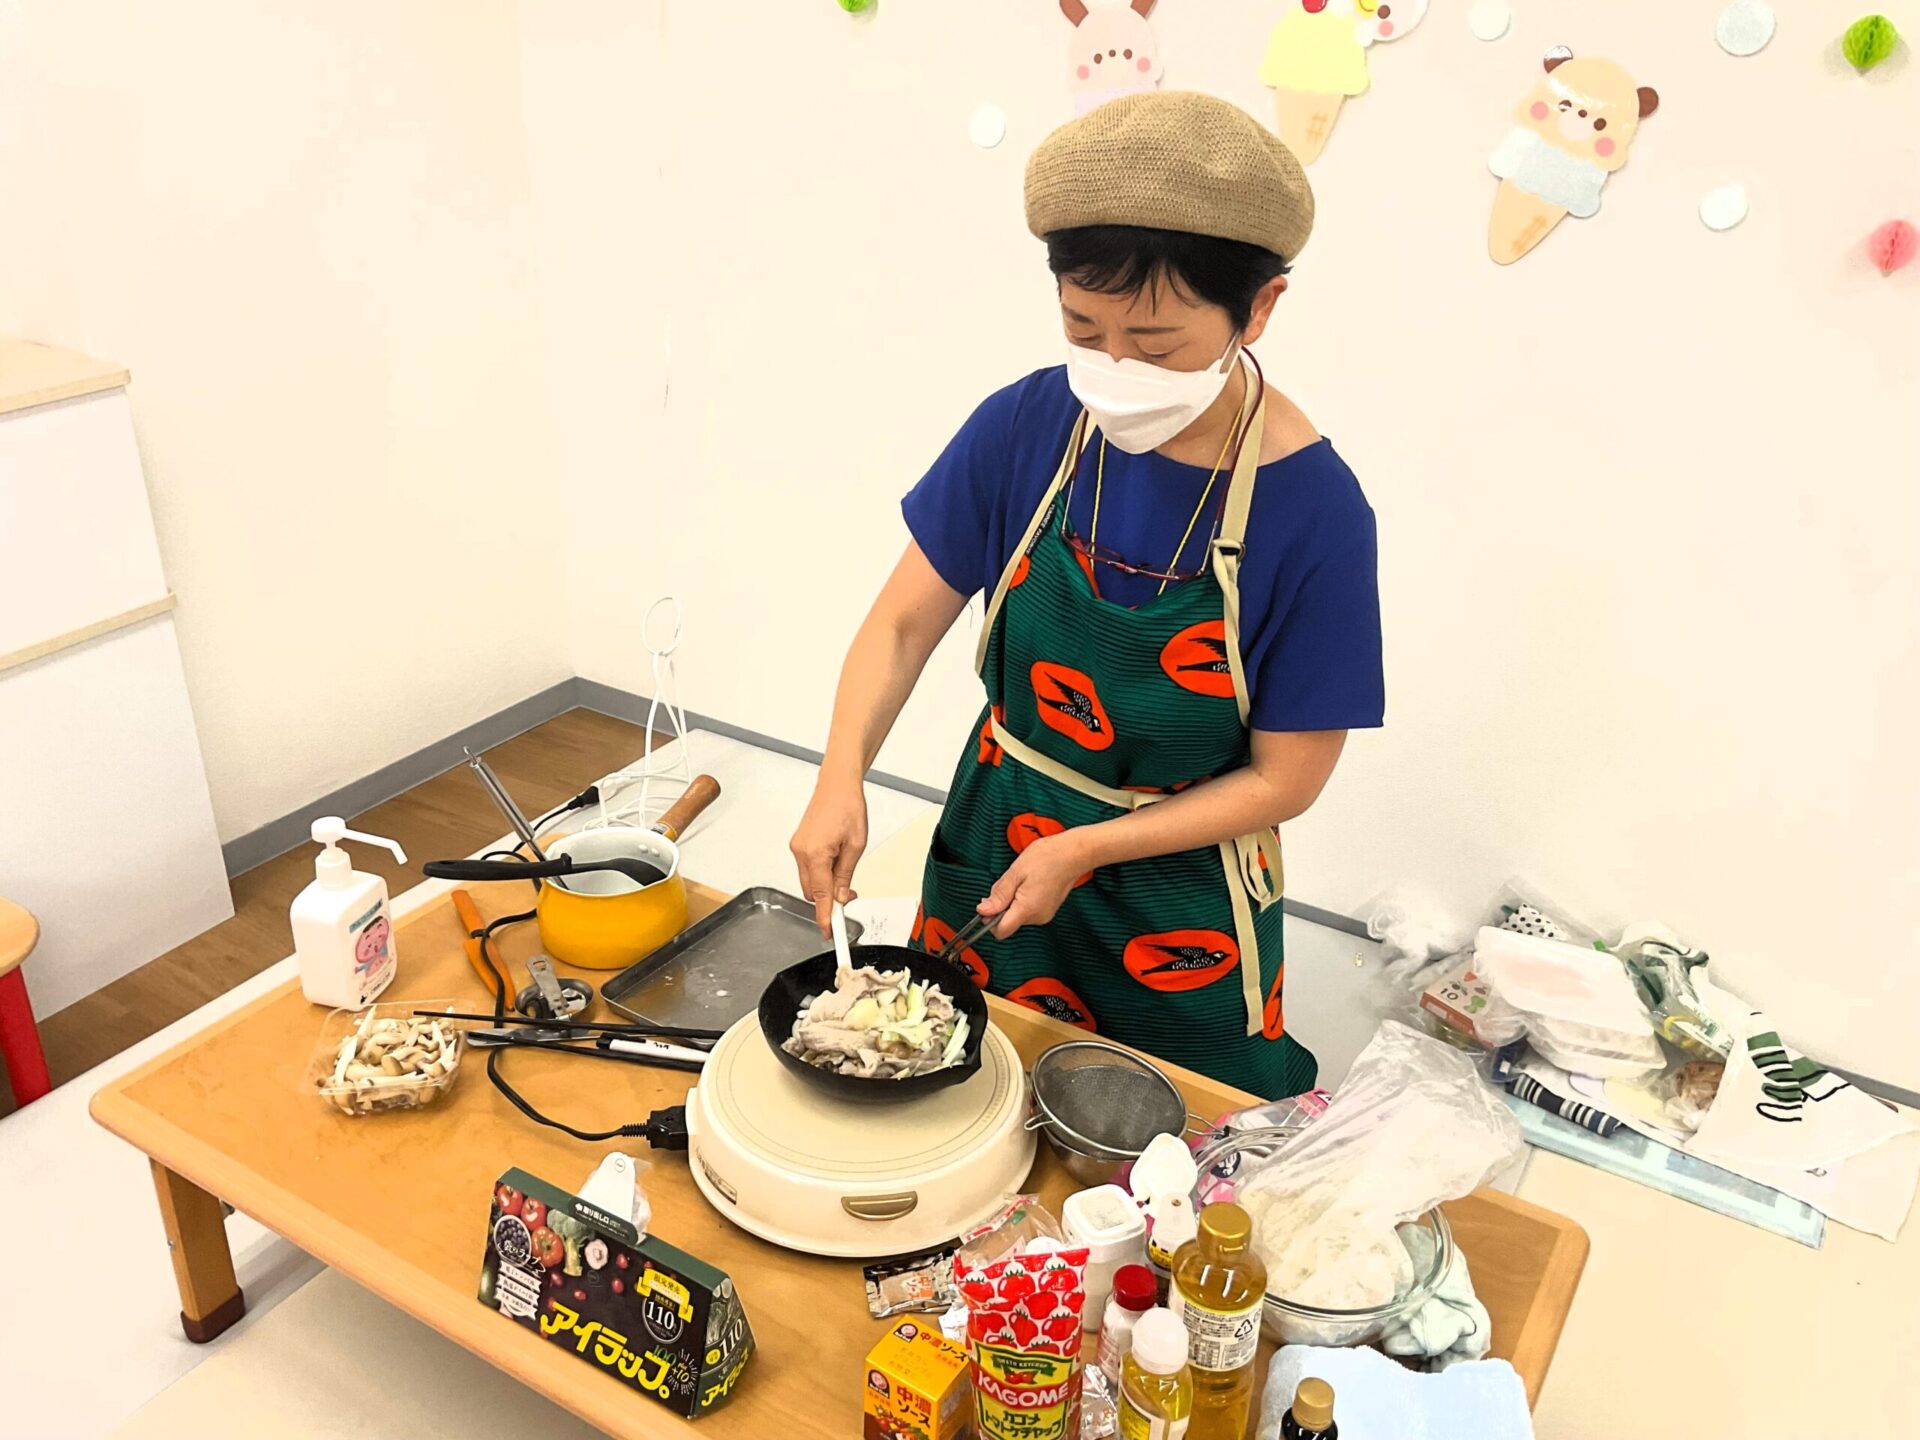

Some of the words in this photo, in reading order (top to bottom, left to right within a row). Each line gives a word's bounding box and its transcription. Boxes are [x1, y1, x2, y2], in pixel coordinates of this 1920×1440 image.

[719, 1318, 743, 1361] 110
[919, 1331, 969, 1363] 中濃ソース
[896, 1385, 932, 1417] 中濃
[978, 1370, 1070, 1408] KAGOME
[898, 1398, 932, 1430] ソース
[985, 1408, 1063, 1440] トマトケチャップ
[1002, 1410, 1041, 1426] カゴメ
